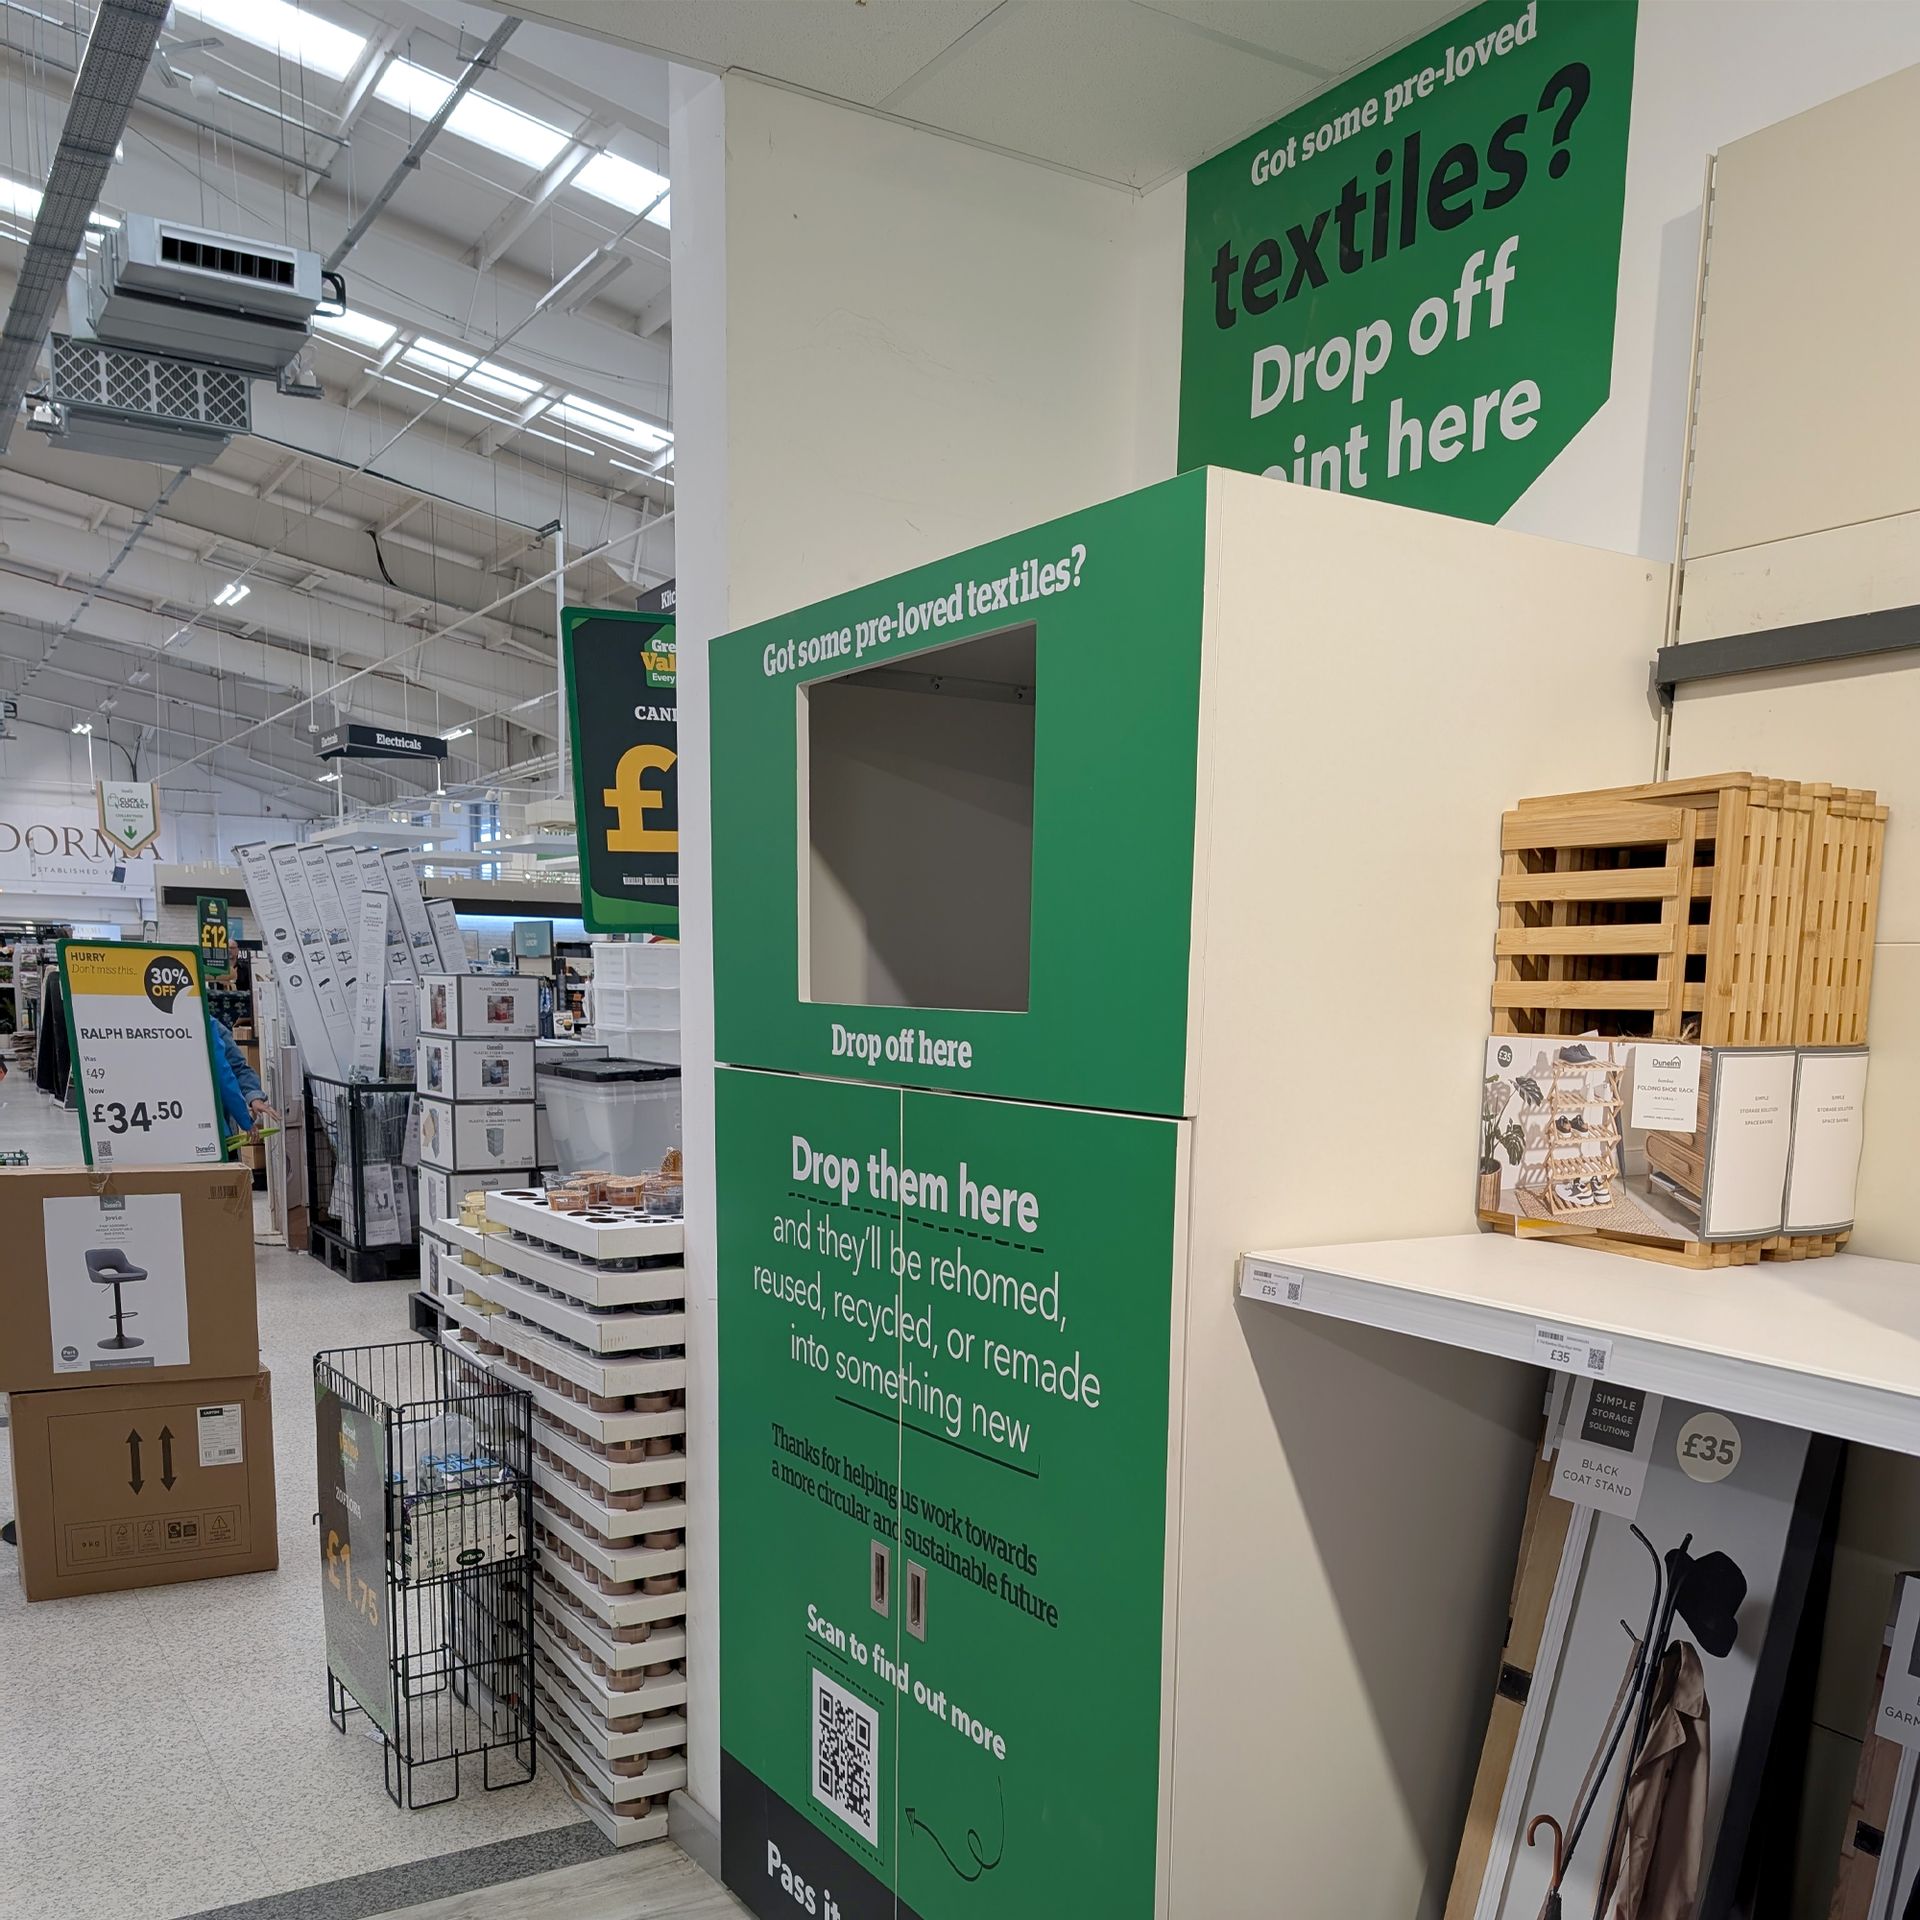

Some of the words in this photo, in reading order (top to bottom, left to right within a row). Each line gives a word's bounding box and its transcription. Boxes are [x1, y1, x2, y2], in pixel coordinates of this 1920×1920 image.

[1251, 137, 1297, 186] Got
[1301, 97, 1378, 162] some
[1383, 1, 1537, 124] pre-loved
[1211, 62, 1591, 330] textiles?
[1250, 319, 1392, 419] Drop
[1408, 235, 1519, 356] off
[1388, 379, 1541, 478] here
[763, 639, 795, 676] Got
[798, 625, 851, 667] some
[855, 582, 963, 658] pre-loved
[967, 544, 1087, 618] textiles?
[376, 733, 421, 750] Electricals
[603, 744, 678, 853] £
[38, 866, 98, 876] STABLISHED
[202, 925, 227, 948] £12
[71, 952, 105, 962] HURRY
[72, 965, 95, 974] Don't
[151, 968, 189, 984] 30%
[152, 985, 176, 997] OFF
[81, 1027, 123, 1040] RALPH
[127, 1027, 192, 1040] BARSTOOL
[831, 1024, 882, 1065] Drop
[885, 1028, 914, 1062] off
[919, 1030, 973, 1068] here
[1499, 1050, 1511, 1061] £35
[1652, 1057, 1682, 1068] Dunelm
[86, 1067, 105, 1079] £49
[93, 1100, 183, 1134] £34.50
[792, 1135, 859, 1205] Drop
[867, 1148, 948, 1213] them
[959, 1162, 1039, 1233] here
[773, 1209, 811, 1251] and
[817, 1214, 881, 1275] they'll
[890, 1230, 921, 1280] be
[930, 1247, 1067, 1333] rehomed,
[1262, 1285, 1276, 1296] £35
[754, 1264, 826, 1320] reused,
[834, 1291, 938, 1358] recycled,
[947, 1328, 974, 1363] or
[984, 1337, 1100, 1408] remade
[1550, 1349, 1570, 1363] £35
[791, 1323, 829, 1371] into
[835, 1350, 962, 1438] something
[973, 1402, 1031, 1453] new
[1592, 1407, 1634, 1425] STORAGE
[1595, 1393, 1637, 1412] SIMPLE
[1589, 1421, 1631, 1438] SOLUTIONS
[1682, 1433, 1736, 1465] £35
[1582, 1459, 1619, 1477] BLACK
[1563, 1470, 1591, 1489] COAT
[1595, 1479, 1632, 1497] STAND
[772, 1423, 820, 1466] Thanks
[822, 1447, 842, 1474] for
[844, 1456, 899, 1508] helping
[901, 1488, 919, 1515] us
[921, 1497, 962, 1537] work
[964, 1516, 1038, 1576] towards
[771, 1459, 780, 1479] a
[781, 1463, 815, 1496] more
[817, 1482, 869, 1525] circular
[873, 1512, 901, 1541] and
[905, 1527, 998, 1595] sustainable
[1000, 1573, 1059, 1628] future
[807, 1604, 845, 1653] Scan
[849, 1633, 868, 1664] to
[873, 1646, 909, 1693] find
[913, 1679, 946, 1720] out
[952, 1704, 1006, 1760] more
[767, 1839, 816, 1915] Pass
